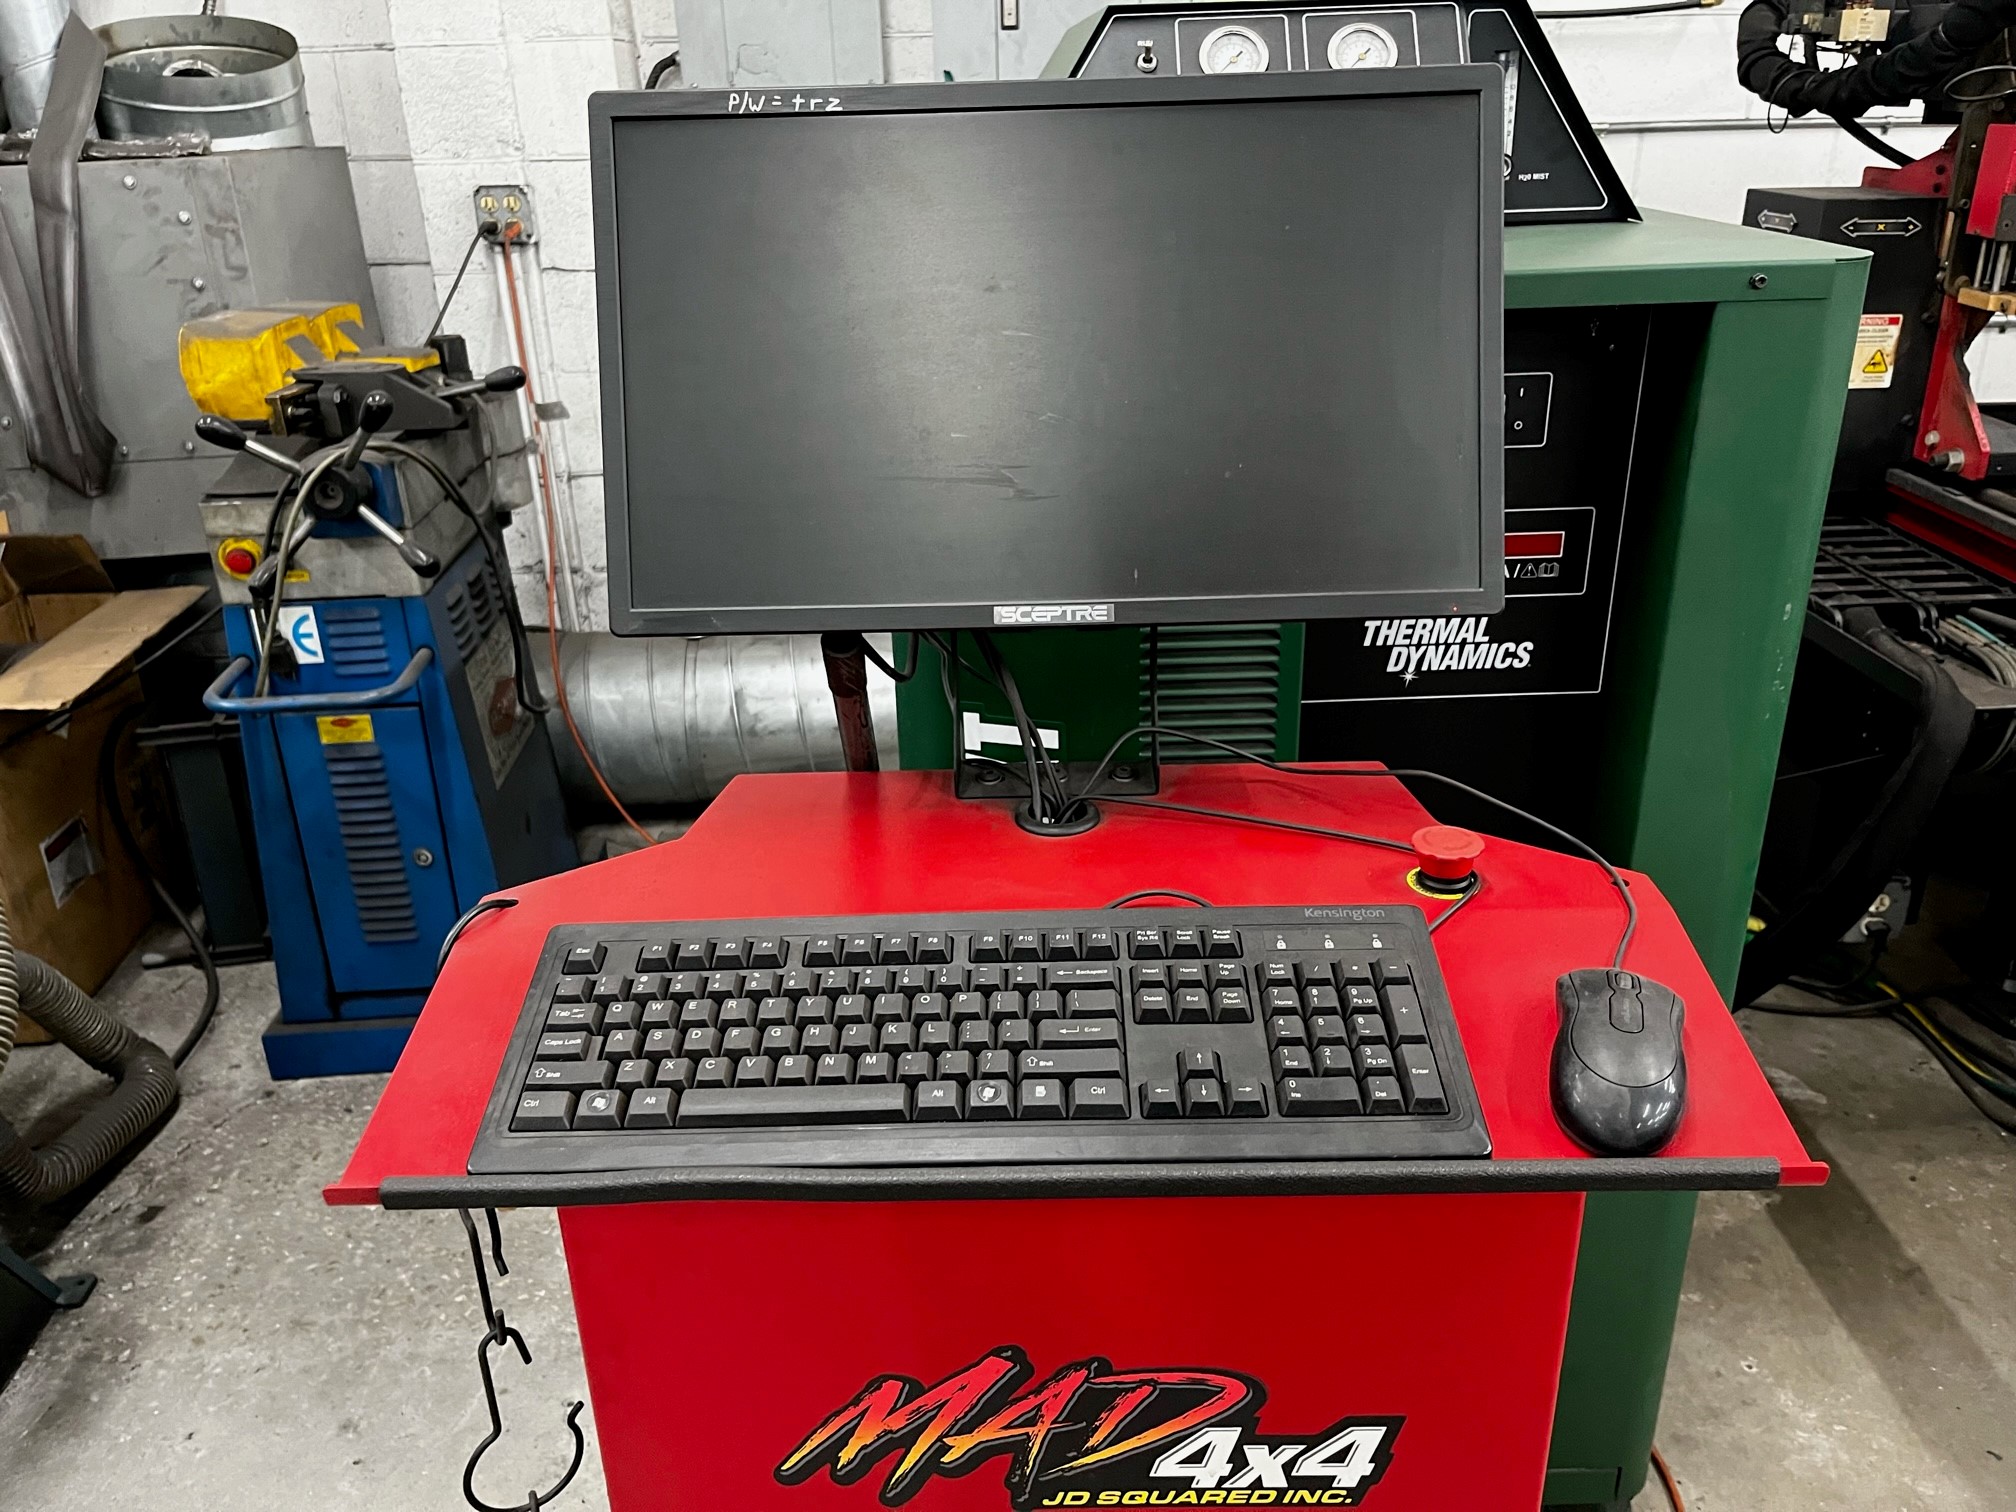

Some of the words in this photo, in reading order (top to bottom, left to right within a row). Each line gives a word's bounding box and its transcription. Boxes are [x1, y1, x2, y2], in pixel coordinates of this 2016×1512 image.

[1000, 605, 1107, 622] SCEPTRE
[1364, 617, 1489, 646] THERMAL
[1386, 642, 1534, 672] DYNAMICS
[1304, 908, 1384, 920] Kensington
[806, 998, 815, 1006] Y
[843, 997, 852, 1005] U
[920, 995, 930, 1003] O
[959, 994, 968, 1002] P
[612, 1004, 622, 1012] Q
[688, 1001, 698, 1010] E
[727, 1000, 737, 1009] R
[767, 999, 776, 1008] T
[771, 1028, 781, 1036] G
[810, 1027, 820, 1036] H
[849, 1026, 856, 1035] J
[888, 1024, 897, 1033] K
[928, 1024, 935, 1032] L
[614, 1032, 623, 1040] A
[653, 1031, 662, 1040] S
[692, 1030, 702, 1038] D
[731, 1029, 740, 1038] F
[746, 1058, 756, 1067] V
[784, 1057, 794, 1066] B
[825, 1056, 834, 1065] N
[866, 1055, 876, 1064] M
[624, 1062, 634, 1070] Z
[664, 1060, 676, 1069] X
[705, 1060, 716, 1069] C
[932, 1089, 944, 1097] Alt
[1090, 1086, 1106, 1095] Ctrl
[643, 1096, 657, 1104] Alt
[781, 1356, 1248, 1495] MAD
[1149, 1427, 1387, 1488] 4x4
[1042, 1491, 1091, 1505] JD
[1097, 1490, 1279, 1504] SQUARED
[1283, 1490, 1352, 1504] INC.
